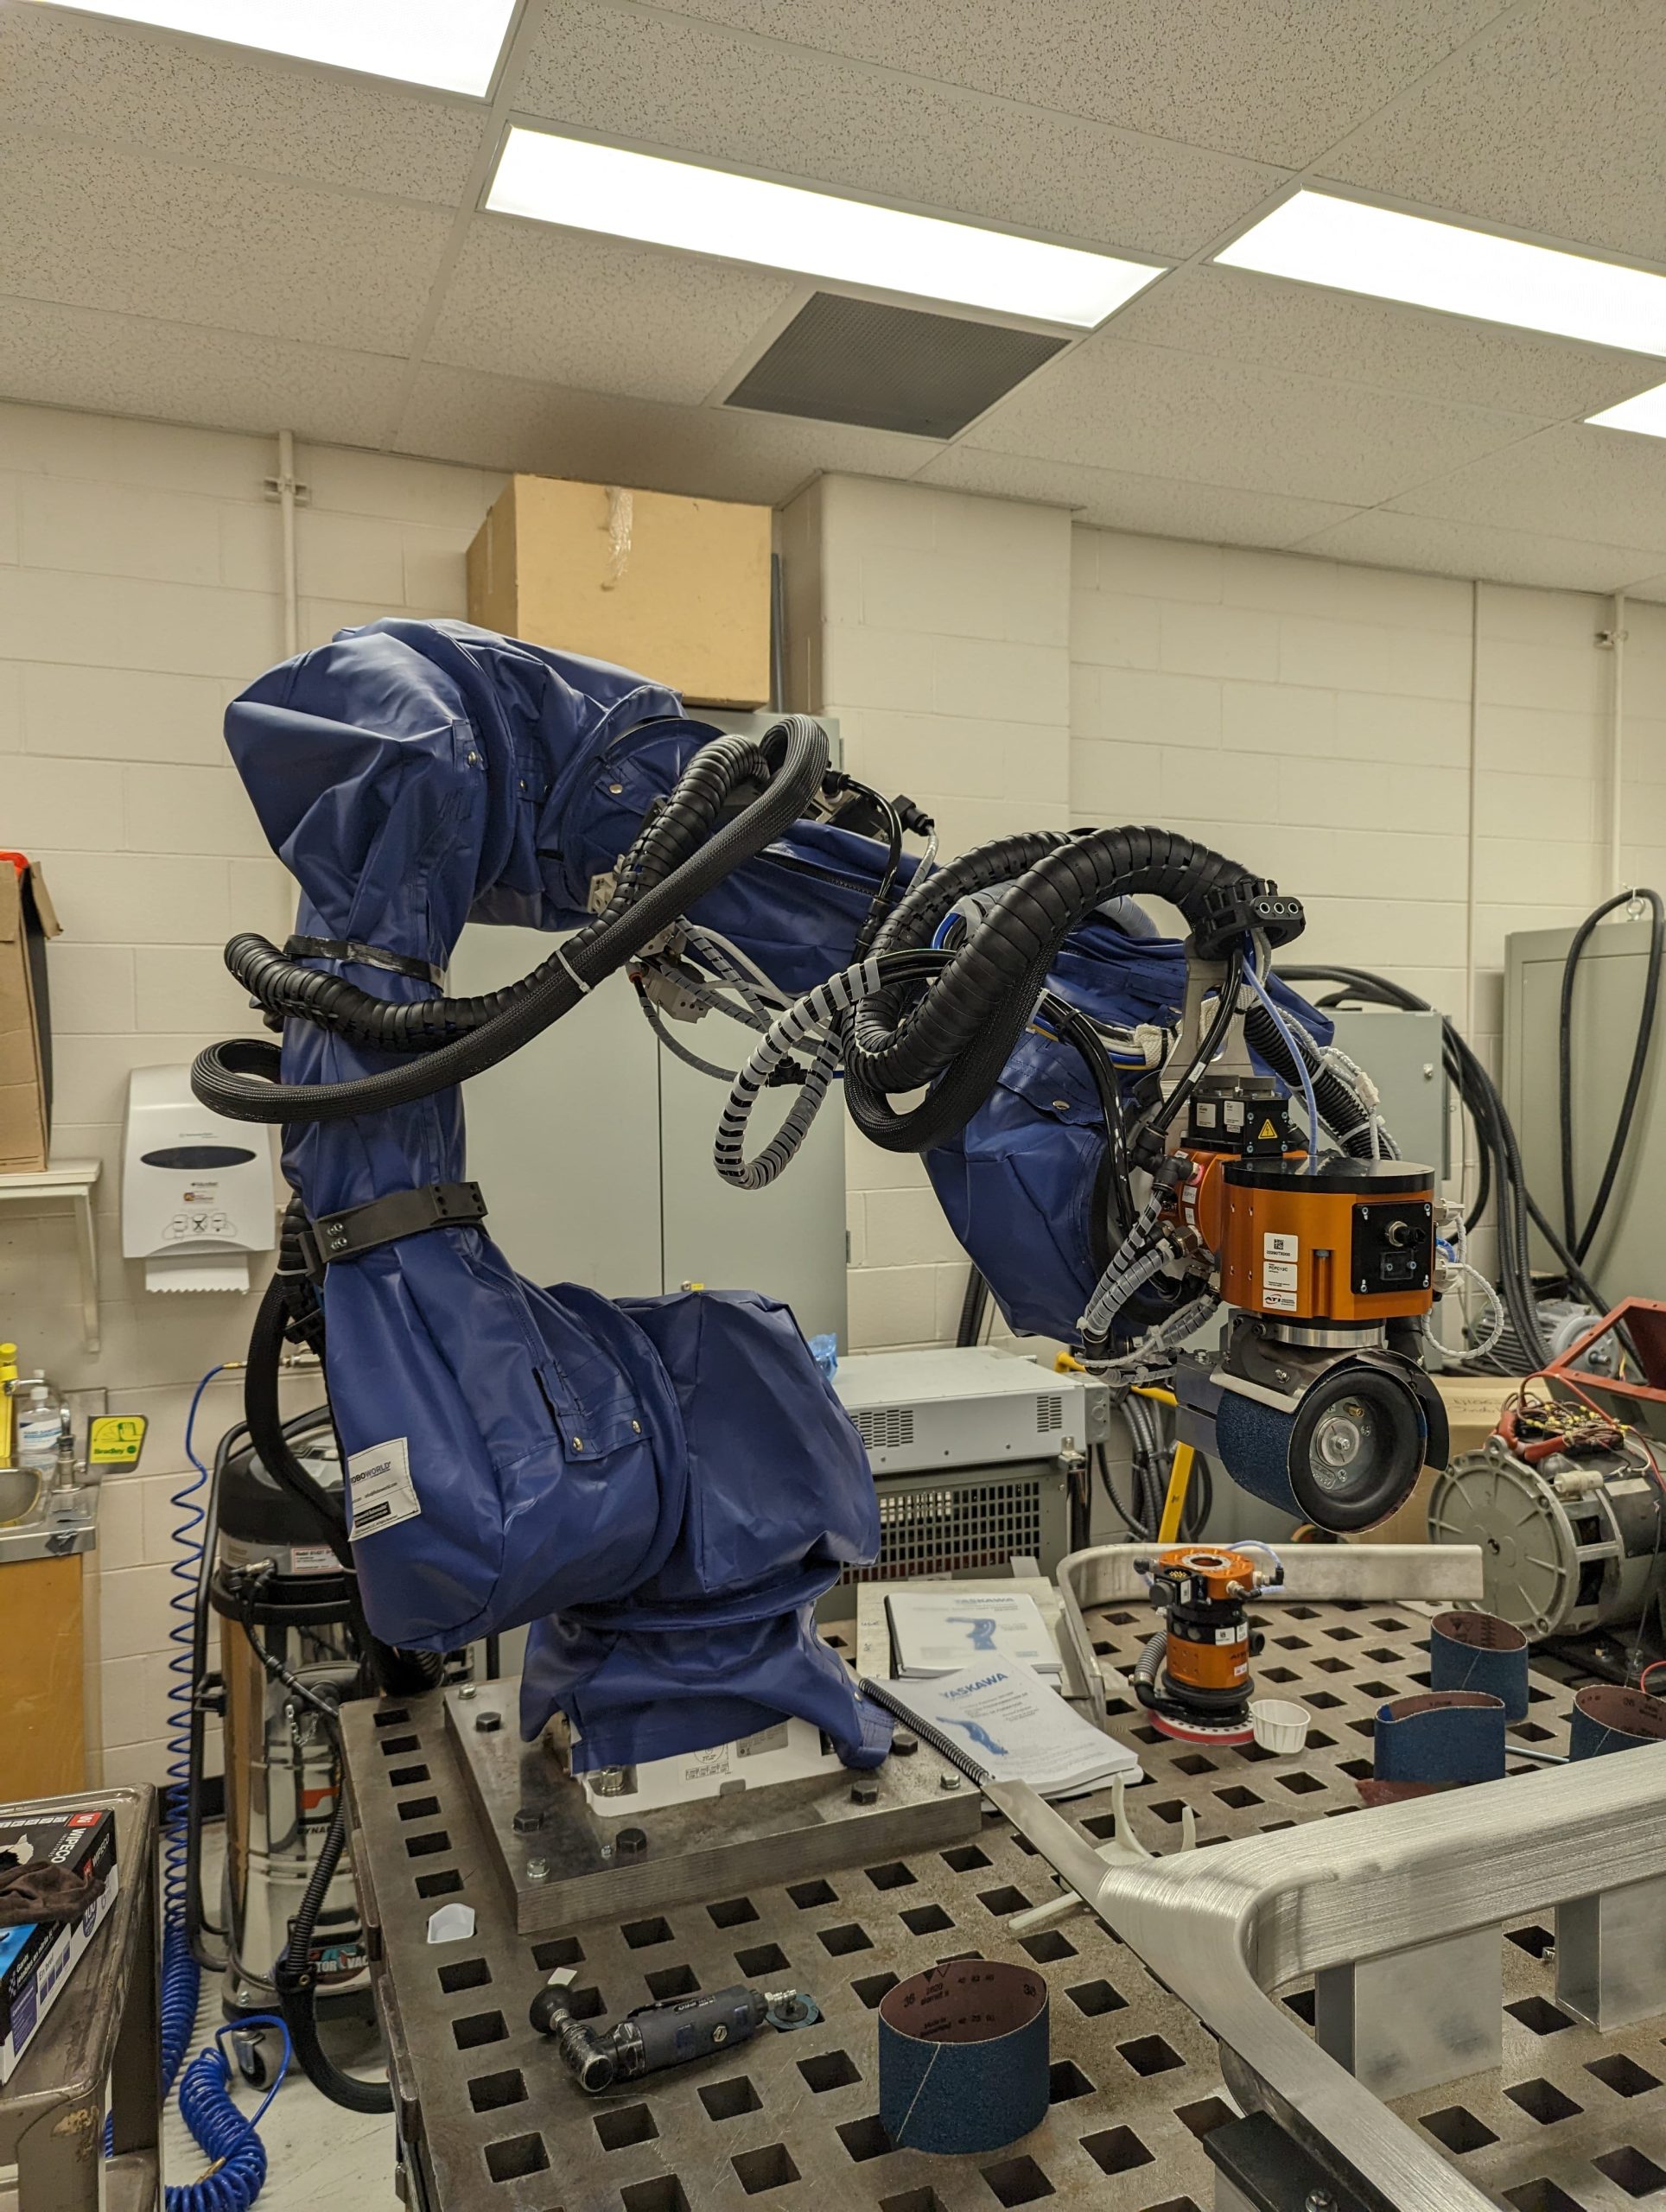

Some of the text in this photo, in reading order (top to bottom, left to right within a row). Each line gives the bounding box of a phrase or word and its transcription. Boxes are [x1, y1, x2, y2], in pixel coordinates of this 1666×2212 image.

[941, 1673, 1008, 1699] YASKAWA
[50, 1827, 86, 1864] WIPECO
[92, 1833, 110, 1866] WIPECO
[904, 1993, 915, 2008] 36
